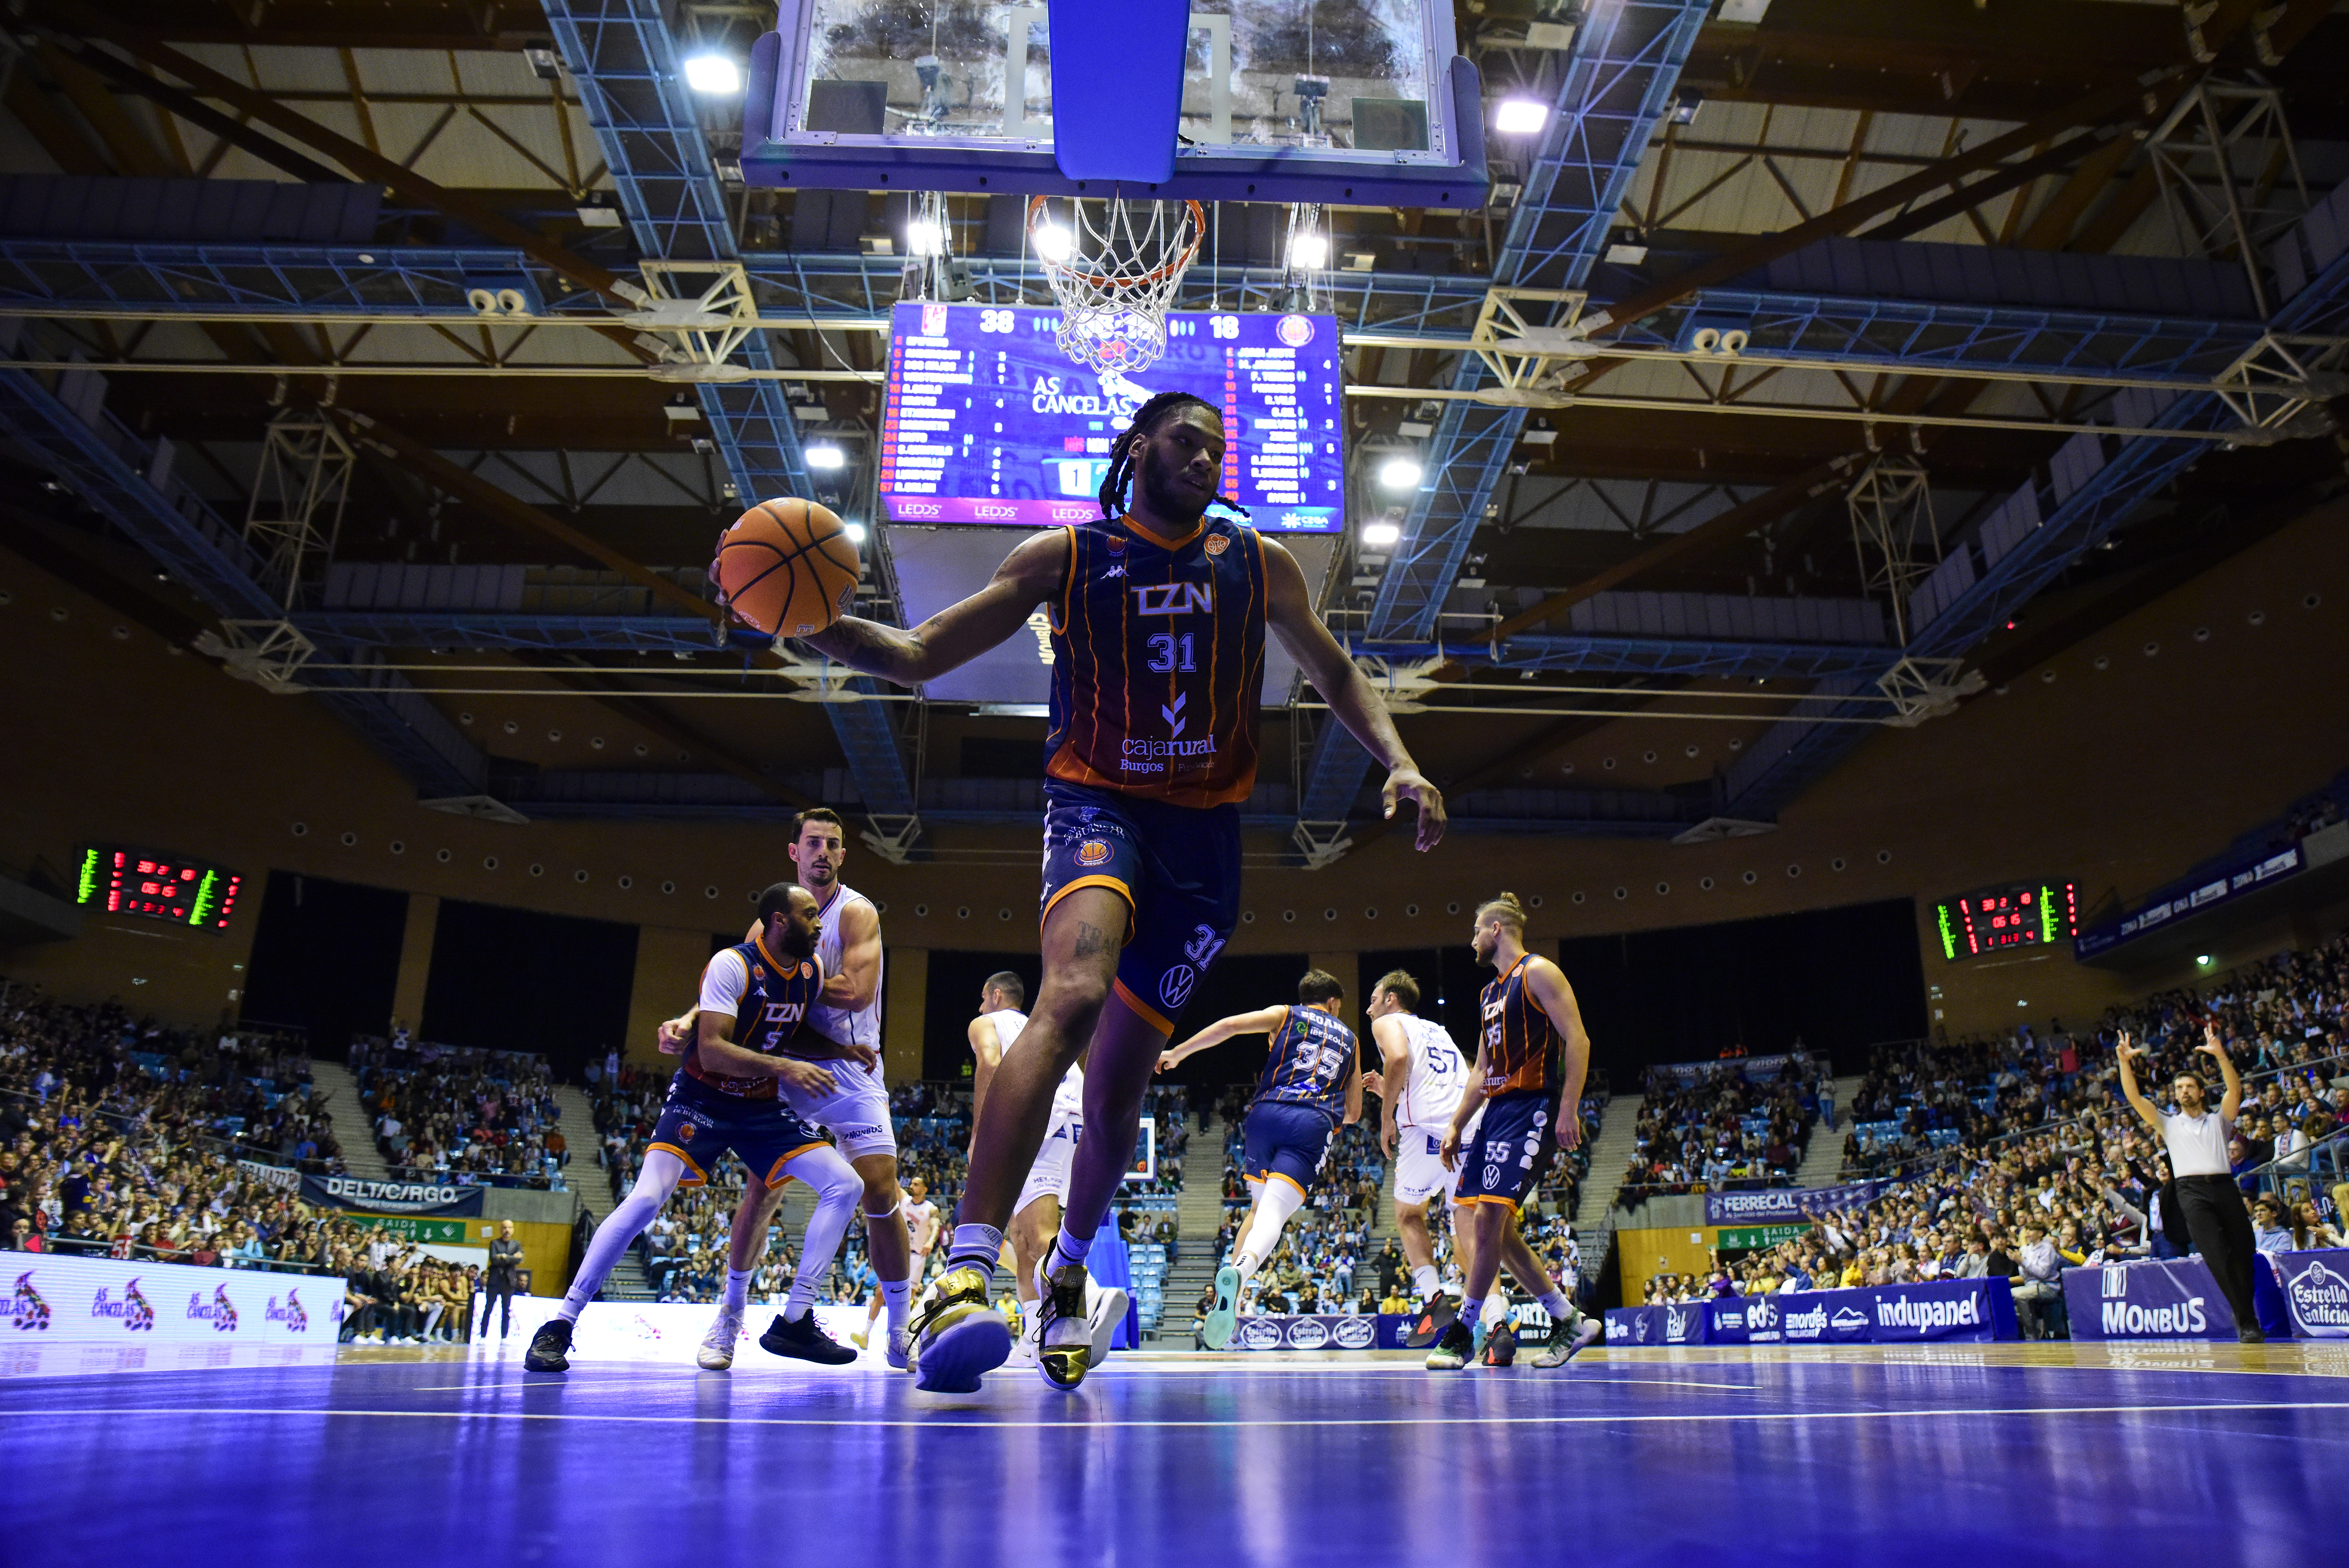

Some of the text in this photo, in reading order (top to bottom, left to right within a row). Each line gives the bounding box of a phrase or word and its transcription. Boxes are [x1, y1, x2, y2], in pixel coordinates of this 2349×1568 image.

[980, 309, 1015, 333] 38
[1209, 315, 1239, 339] 18
[893, 360, 901, 369] 7
[1323, 360, 1331, 369] 4
[891, 372, 900, 381] 9
[998, 375, 1004, 384] 1
[889, 383, 901, 393] 10
[1033, 376, 1060, 395] AS
[1224, 382, 1332, 393] 10 2
[889, 396, 899, 405] 11
[996, 399, 1004, 408] 4
[1032, 394, 1132, 415] CANCELAS
[1325, 395, 1331, 405] 1
[885, 420, 898, 429] 23
[1224, 418, 1237, 427] 24
[1325, 419, 1333, 429] 3
[884, 432, 897, 442] 24
[883, 445, 897, 455] 25
[993, 447, 1001, 457] 4
[1226, 442, 1237, 451] 31
[881, 457, 896, 466] 28
[992, 459, 1001, 469] 2
[1224, 454, 1238, 463] 33
[880, 469, 999, 482] 29 4
[1328, 480, 1336, 490] 3
[1147, 632, 1196, 672] 31
[1122, 734, 1217, 761] cajarural
[1120, 759, 1163, 773] Burgos
[1982, 898, 1995, 911] 38
[2000, 897, 2007, 908] 2
[1992, 915, 2007, 928] 06
[1184, 924, 1226, 971] 31
[1301, 1011, 1348, 1037] SEOANE
[761, 1031, 784, 1050] 5
[1310, 1028, 1351, 1054] IBEREÓLICA
[1292, 1041, 1344, 1079] 35
[1426, 1046, 1457, 1074] 57
[849, 1125, 883, 1139] MONBUS
[1485, 1141, 1512, 1163] 55
[1724, 1193, 1797, 1212] FERRECAL
[378, 1218, 416, 1228] SAIDA
[1762, 1226, 1799, 1236] SAIDA
[95, 1288, 108, 1301] AS
[2294, 1284, 2348, 1304] Estrella
[1875, 1291, 1980, 1334] indupanel
[2102, 1297, 2206, 1335] MONBUS
[2300, 1303, 2349, 1324] Galicia
